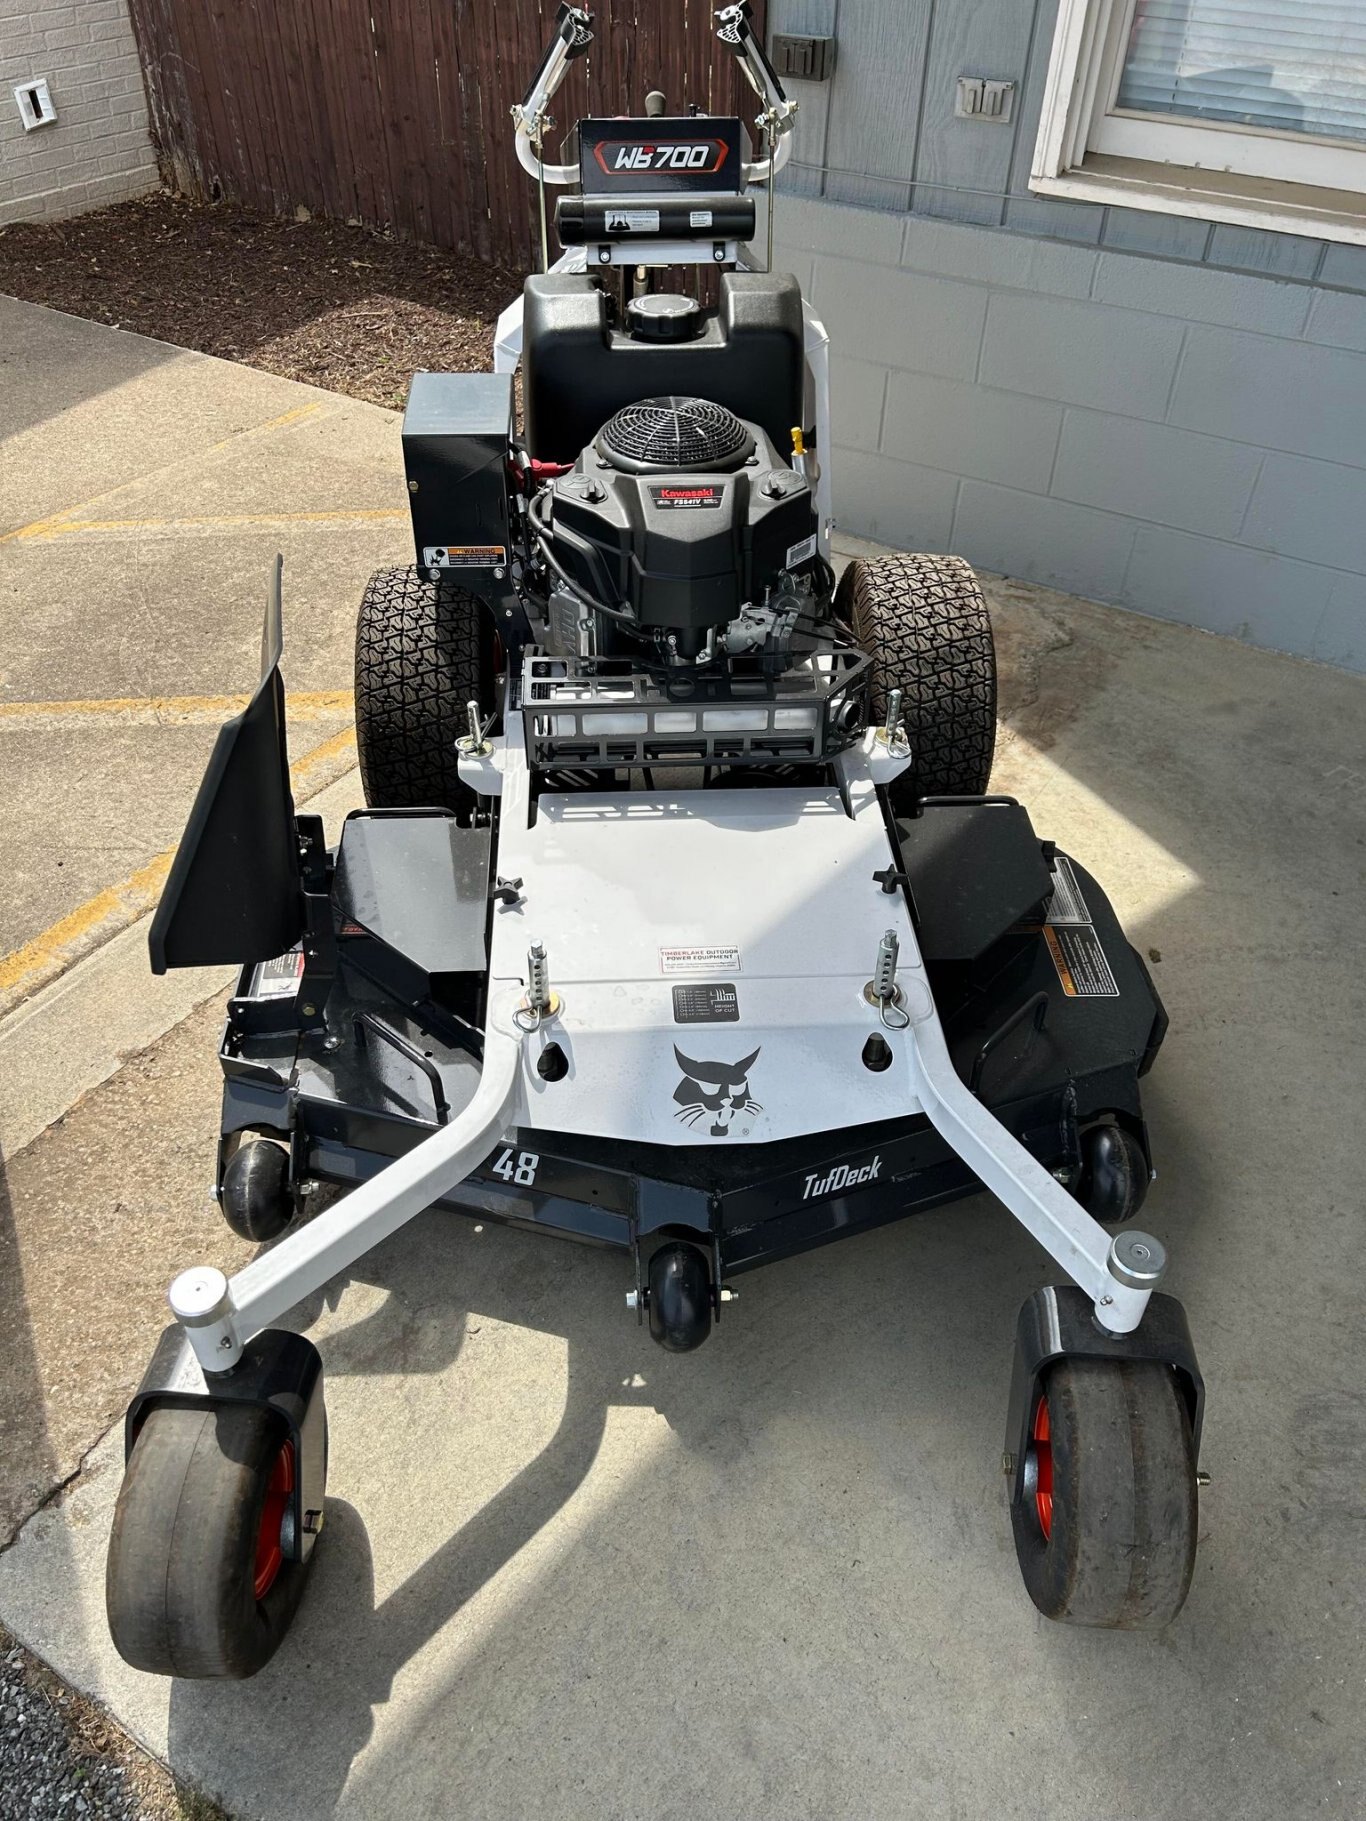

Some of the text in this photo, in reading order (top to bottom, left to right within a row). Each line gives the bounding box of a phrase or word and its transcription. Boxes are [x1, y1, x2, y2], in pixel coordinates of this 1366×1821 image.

[614, 145, 710, 169] WB700
[661, 488, 713, 498] Kawasaki
[1049, 941, 1068, 975] WARNING
[492, 1148, 540, 1187] 48
[803, 1155, 883, 1200] TufDeck
